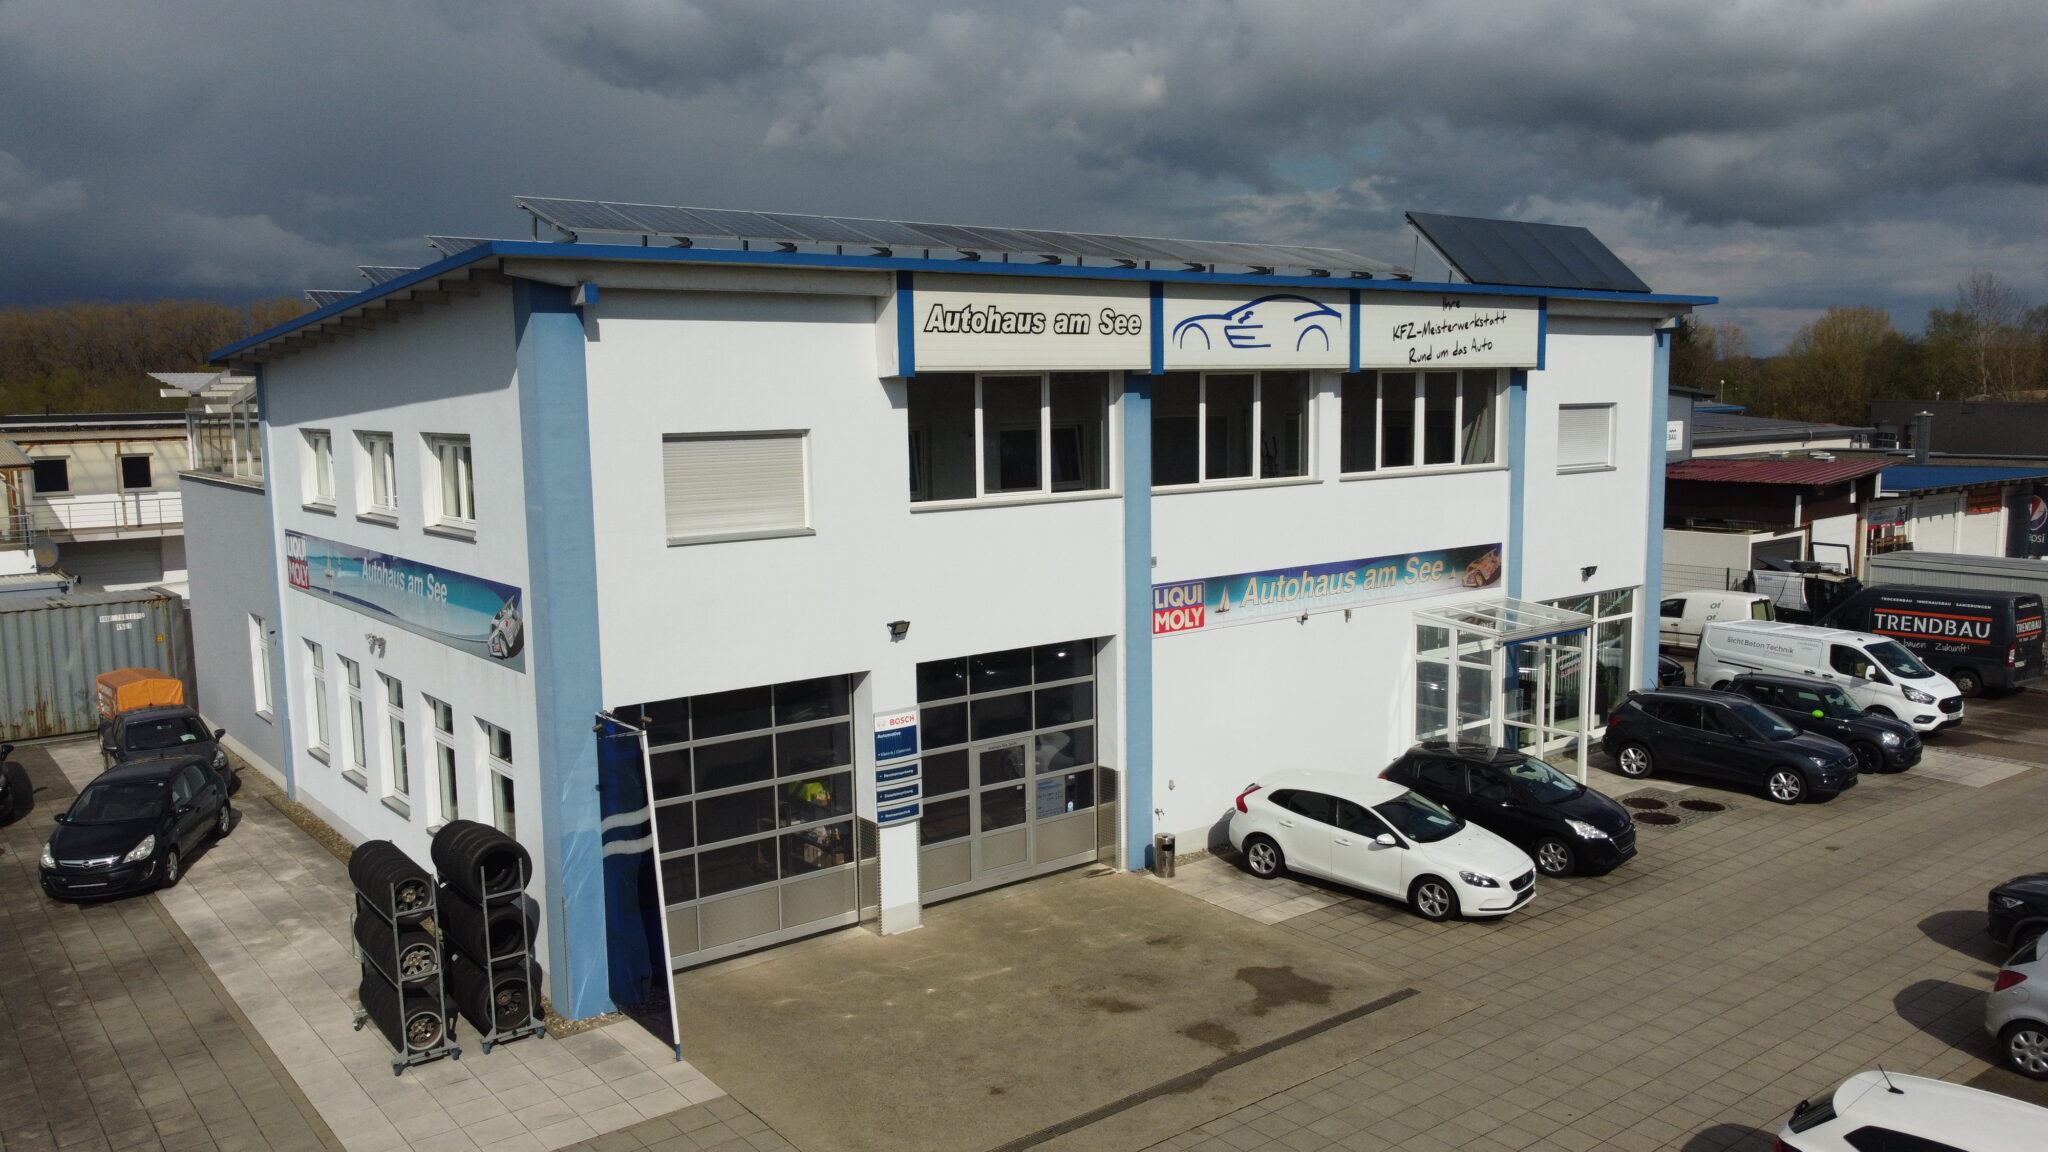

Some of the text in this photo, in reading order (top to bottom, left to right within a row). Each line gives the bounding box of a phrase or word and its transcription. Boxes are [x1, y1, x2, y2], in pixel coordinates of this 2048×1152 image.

[1442, 296, 1461, 311] Ihre
[923, 304, 1142, 335] Autohaus am See
[1392, 310, 1507, 341] KFZ-Meisterwerkstatt
[1409, 337, 1493, 364] Rund um das Auto
[286, 535, 307, 560] LIQUI
[288, 560, 308, 587] MOLY
[362, 556, 448, 603] Autohaus am See
[1239, 556, 1444, 608] Autohaus am See
[1154, 583, 1203, 610] LIQUI
[1154, 604, 1204, 632] MOLY
[1874, 613, 1990, 639] TRENDBAU
[2015, 619, 2042, 634] TRENDBAU
[1766, 644, 1794, 654] Technik
[1903, 638, 1927, 649] bauen
[889, 715, 915, 726] BOSCH
